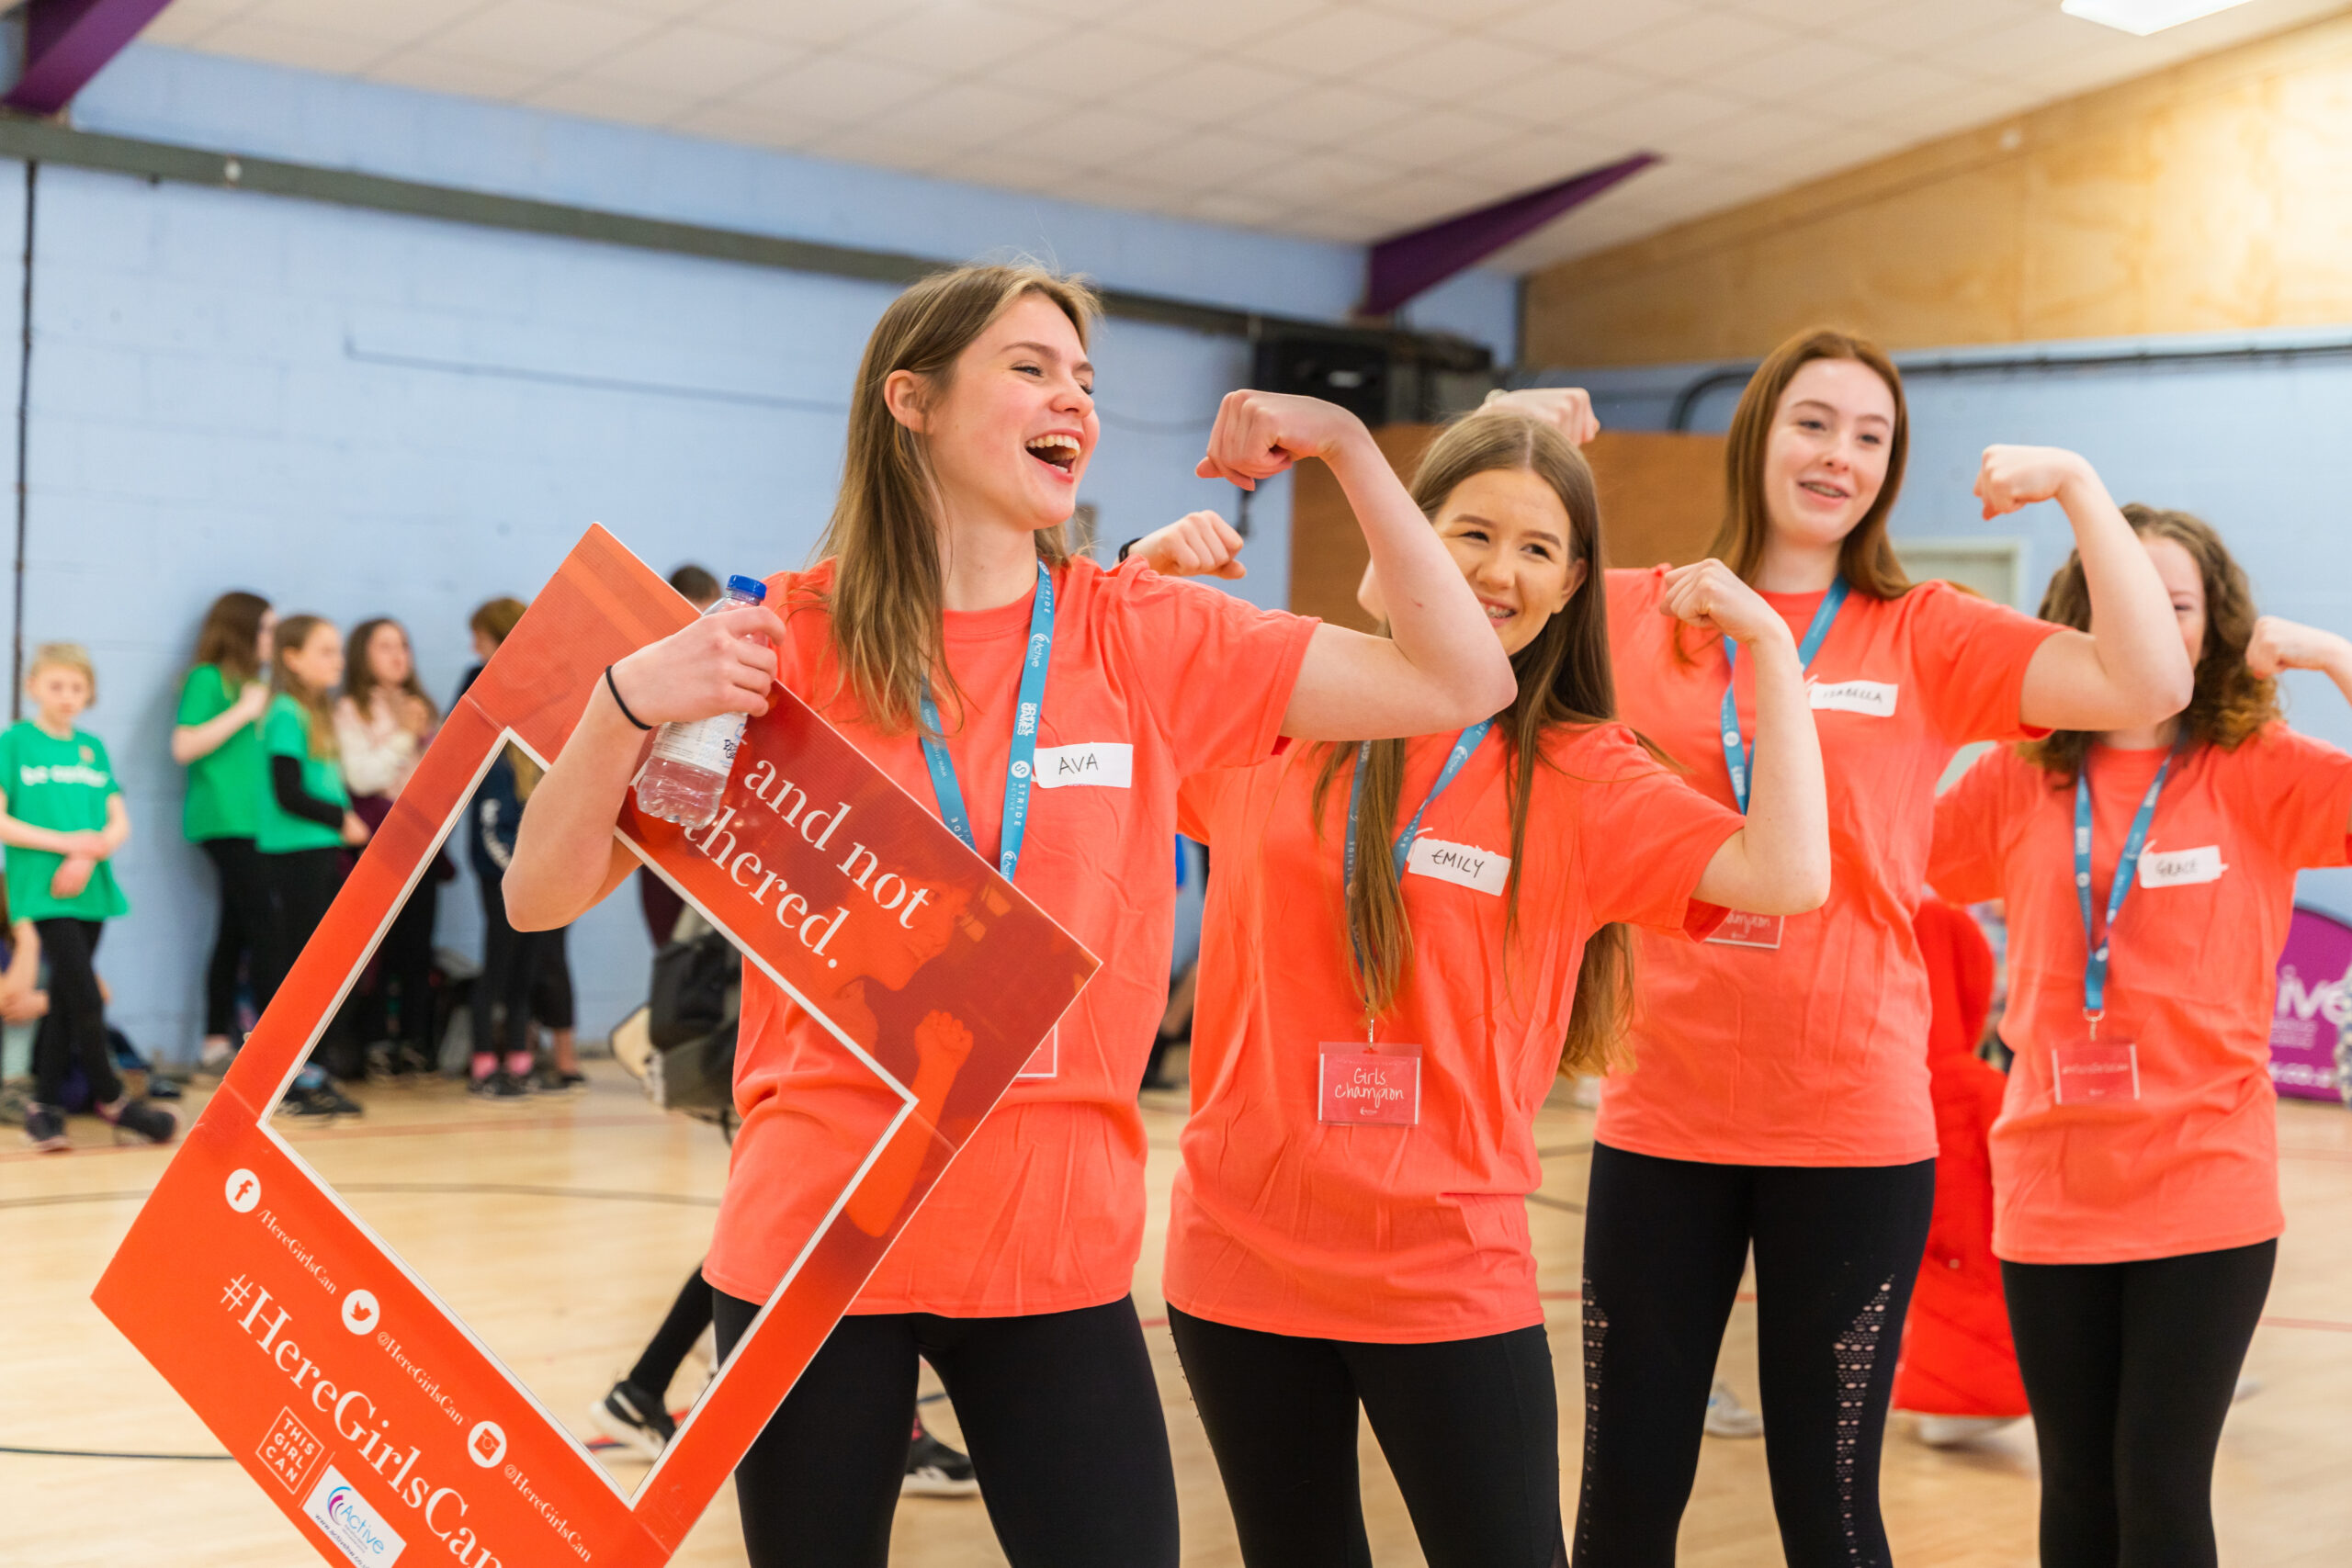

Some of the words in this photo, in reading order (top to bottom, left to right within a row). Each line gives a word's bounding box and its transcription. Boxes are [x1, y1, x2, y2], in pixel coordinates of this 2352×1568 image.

[1031, 642, 1046, 669] Active
[1058, 752, 1099, 776] AVA
[1013, 783, 1027, 827] STRIDE
[743, 760, 853, 852] and
[836, 841, 931, 930] not
[1430, 848, 1485, 879] EMILY
[1353, 1066, 1385, 1086] Girls
[256, 1209, 337, 1295] /HereGirlsCan
[377, 1331, 464, 1426] @HereGirlsCan
[274, 1433, 303, 1470] GIRL
[284, 1417, 315, 1455] THIS
[266, 1446, 299, 1483] CAN
[339, 1505, 385, 1554] Active
[503, 1463, 593, 1562] @HereGirlsCan
